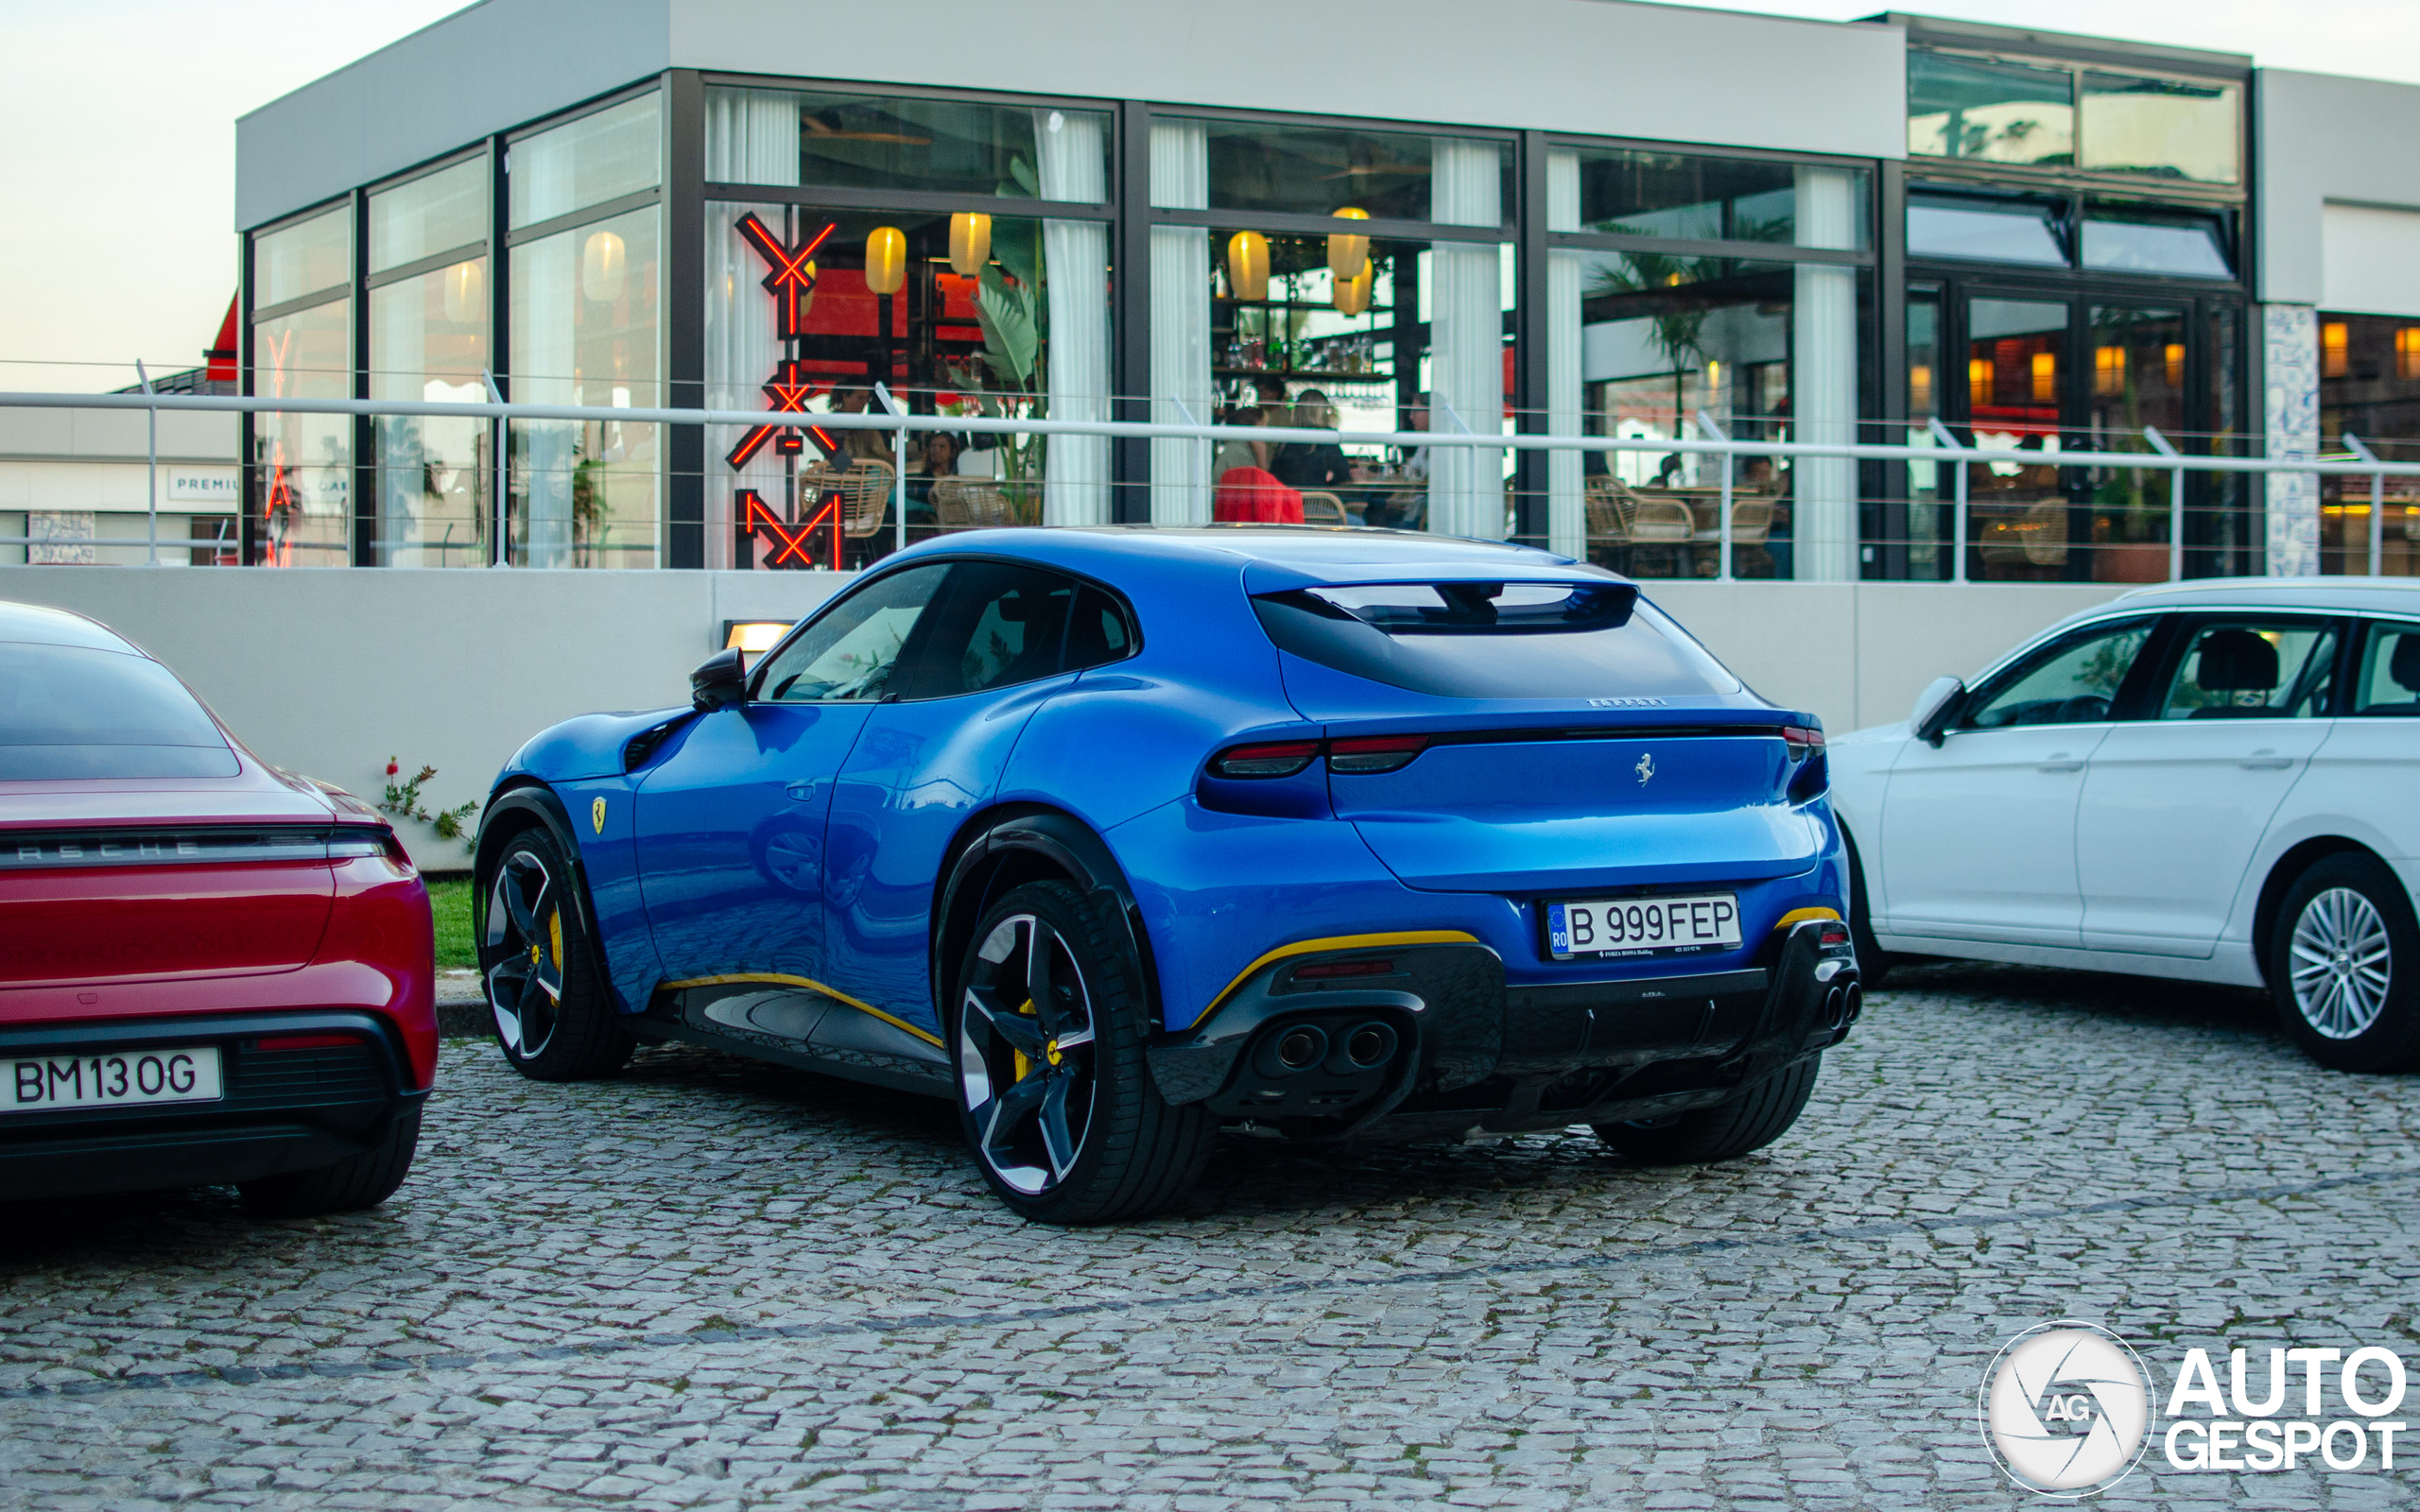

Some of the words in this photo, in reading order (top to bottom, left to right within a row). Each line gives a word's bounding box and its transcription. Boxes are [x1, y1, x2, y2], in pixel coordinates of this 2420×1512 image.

[17, 842, 200, 861] RSCHE
[1570, 908, 1595, 946] B
[1553, 931, 1568, 948] RO
